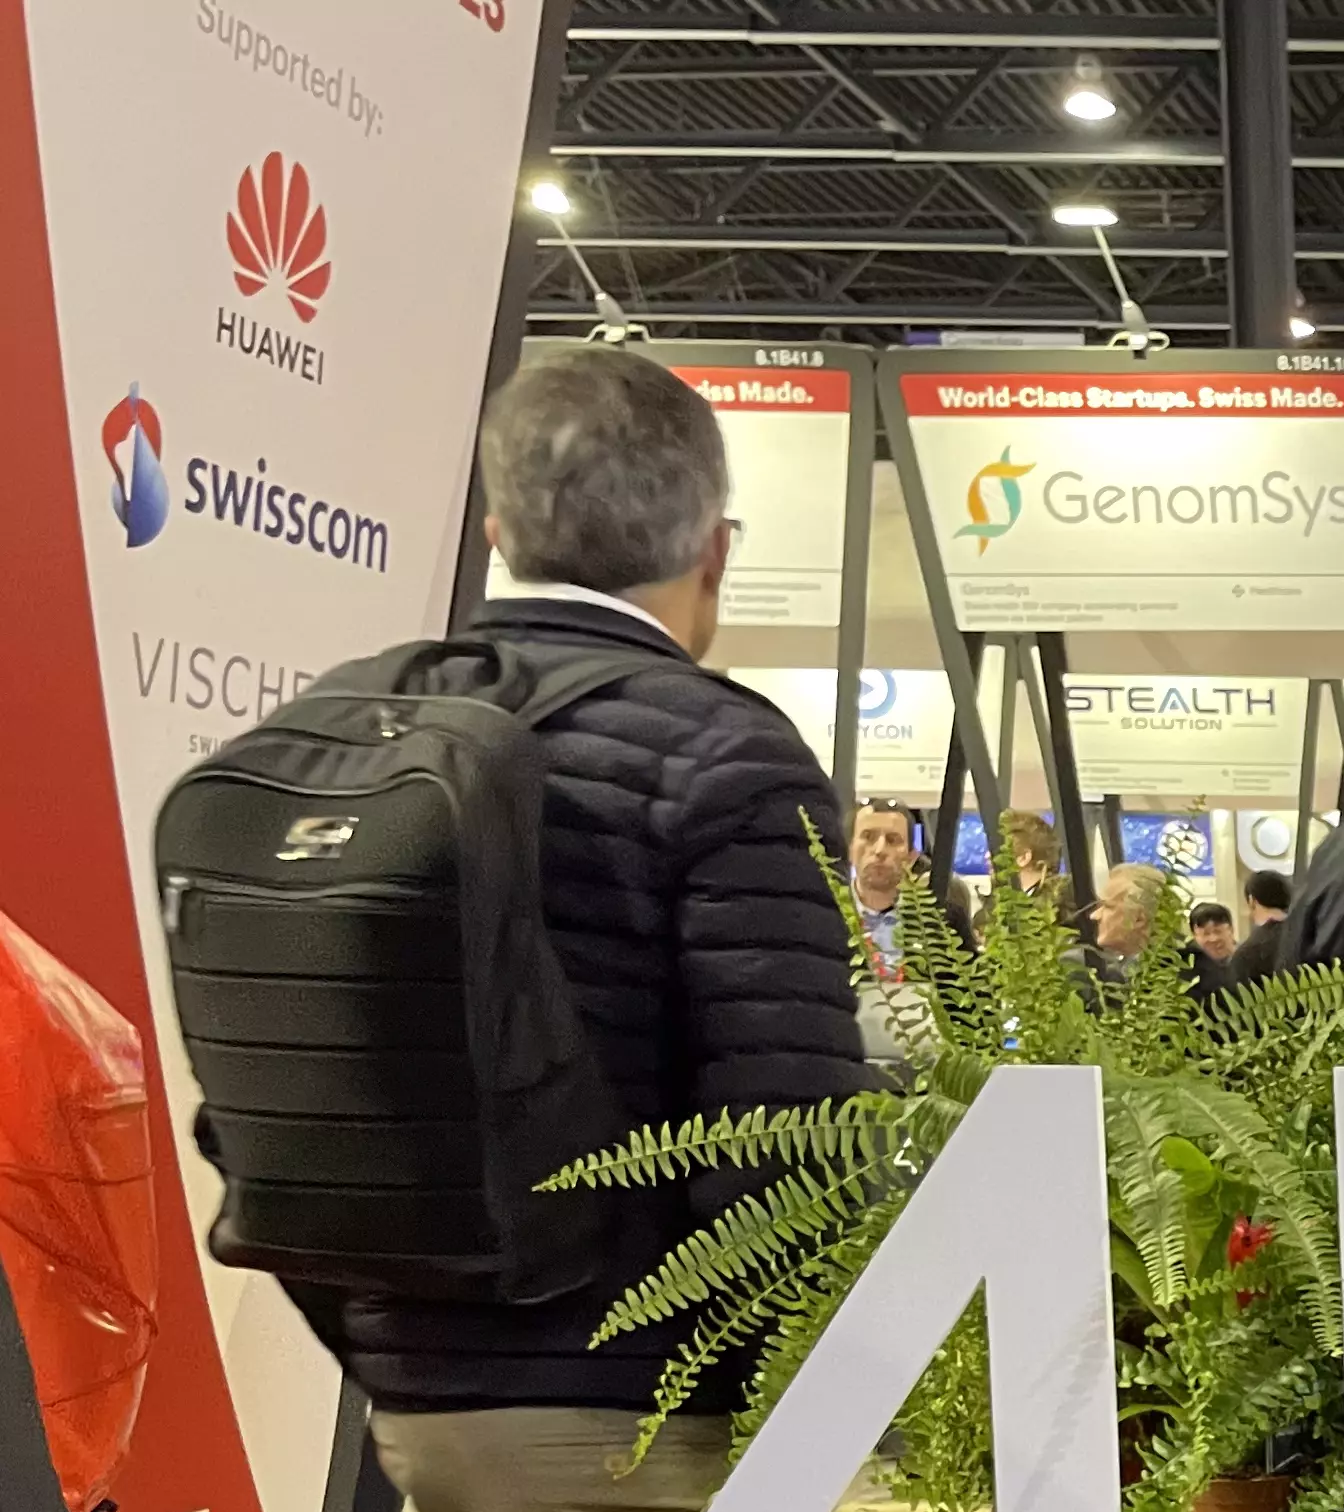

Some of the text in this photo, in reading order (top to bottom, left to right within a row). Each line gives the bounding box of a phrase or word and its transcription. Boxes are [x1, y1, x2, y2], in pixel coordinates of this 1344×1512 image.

[196, 0, 384, 138] Supported by:
[215, 307, 325, 385] HUAWEI
[739, 381, 815, 404] Made.
[937, 386, 1344, 412] World-Class Startups. Swiss Made.
[184, 458, 389, 572] swisscom
[1067, 686, 1276, 715] STEALTH
[1121, 717, 1223, 731] SOLUTION
